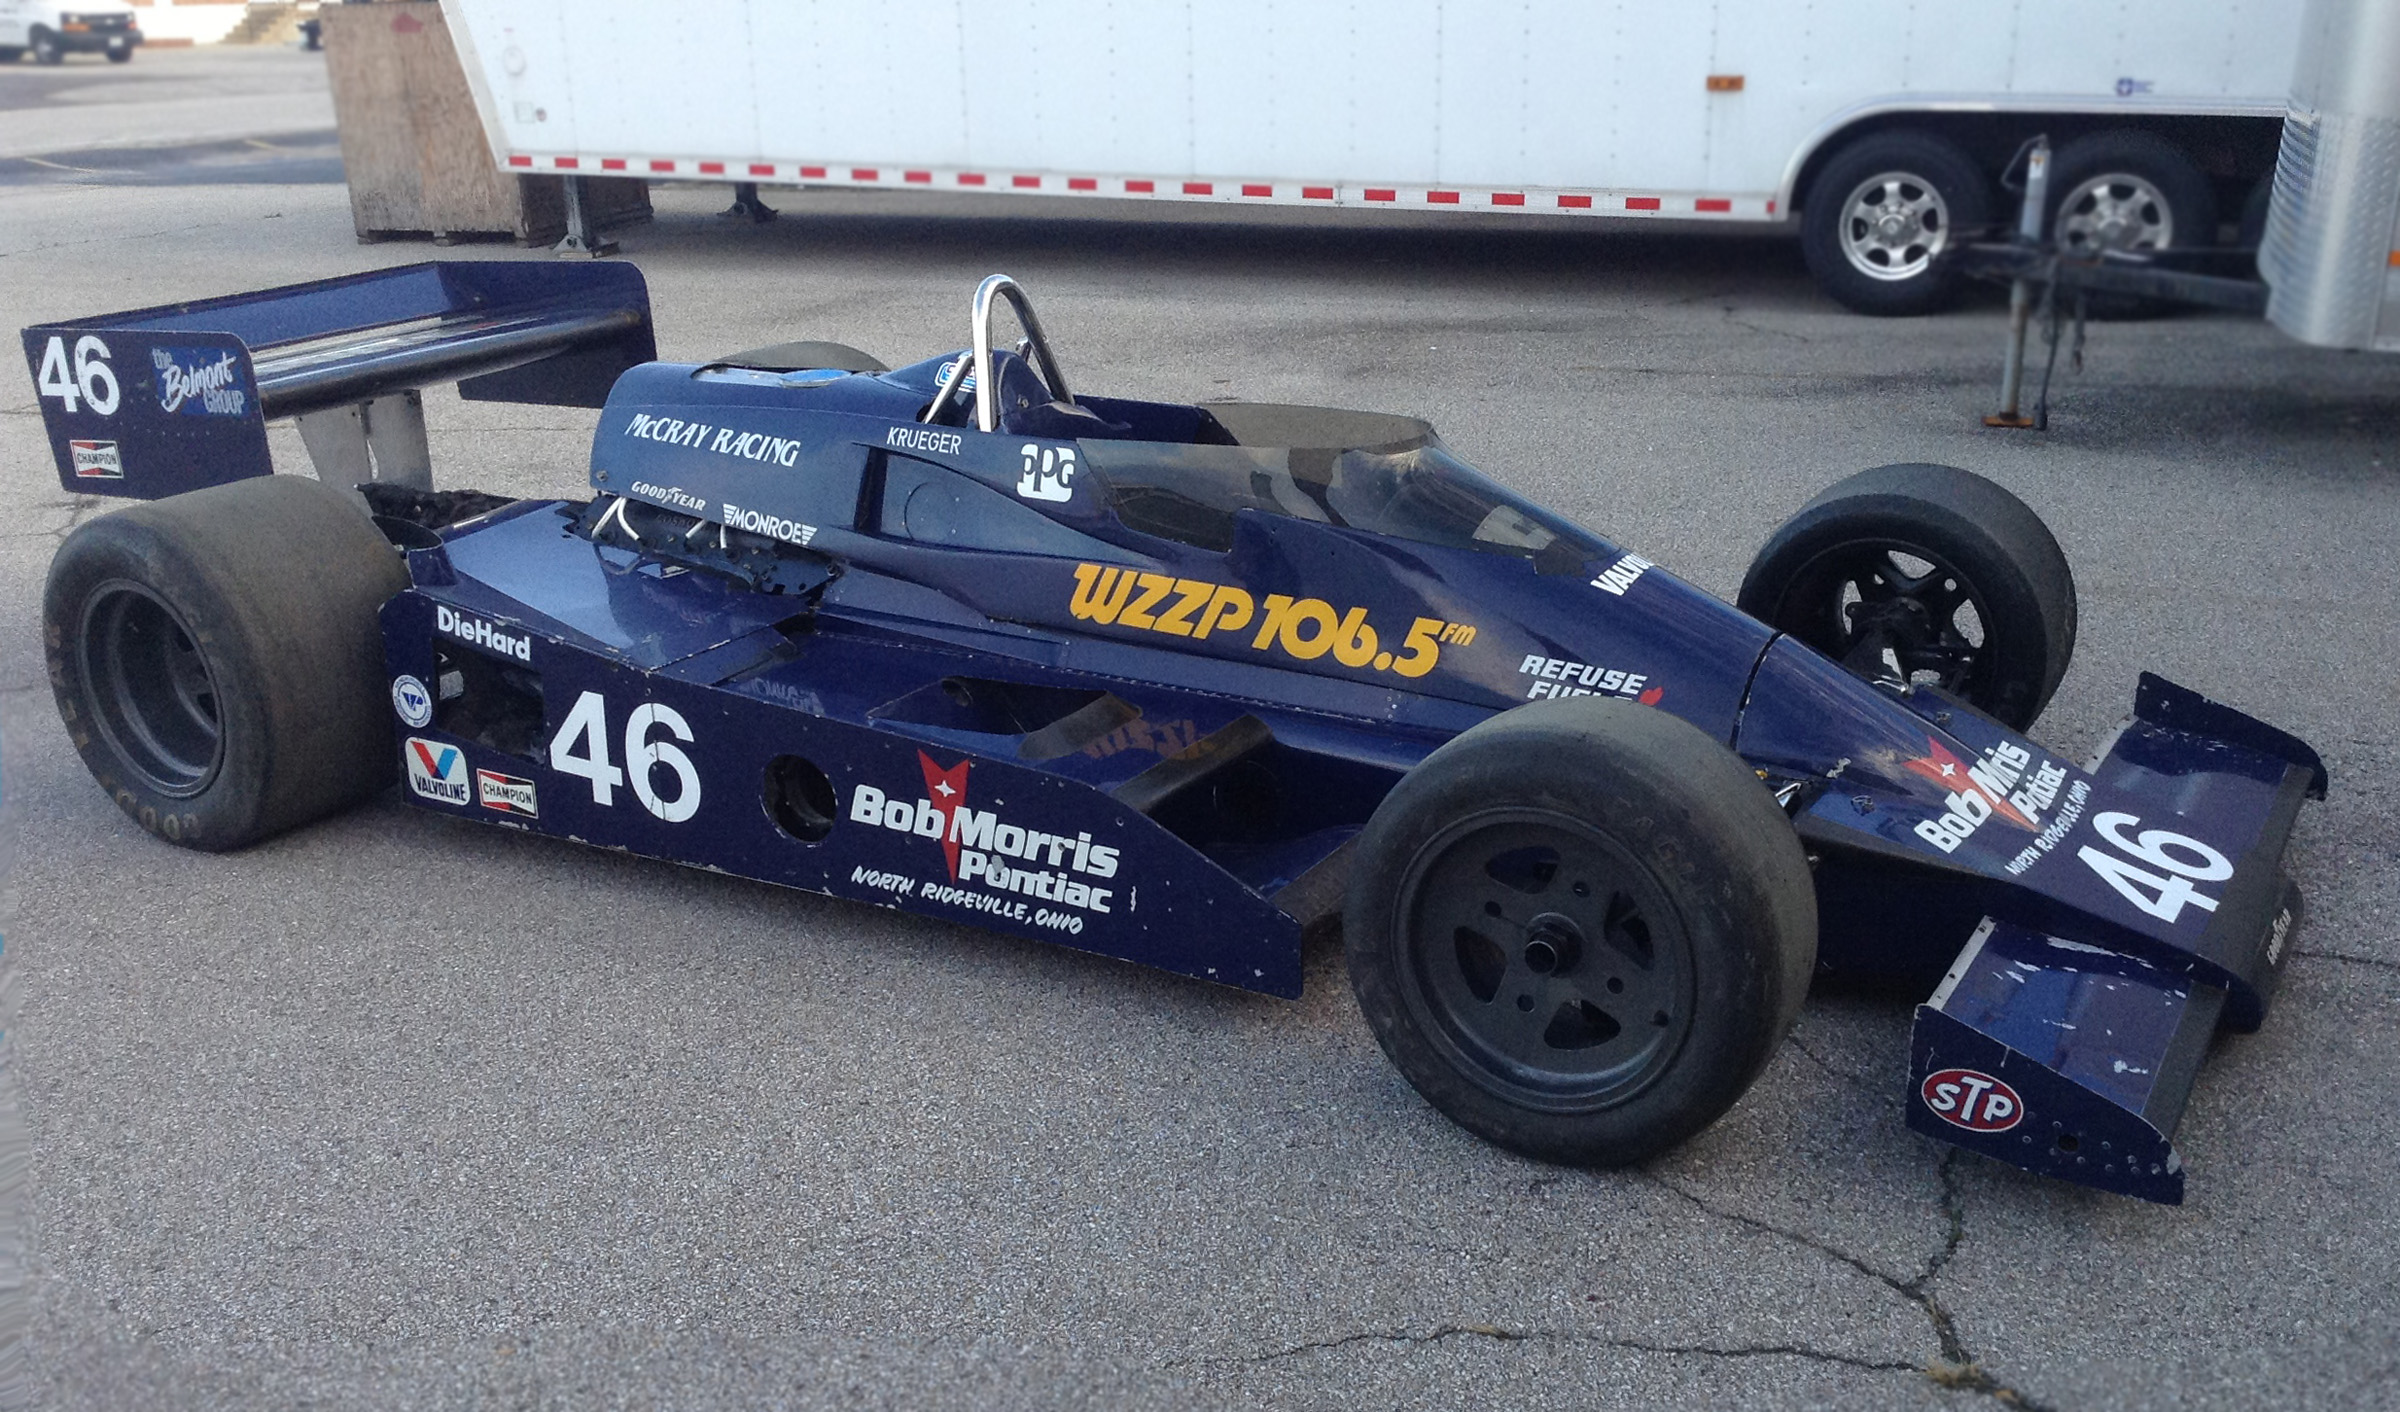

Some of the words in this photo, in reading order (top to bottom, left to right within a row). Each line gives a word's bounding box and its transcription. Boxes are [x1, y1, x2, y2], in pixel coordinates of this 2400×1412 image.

[38, 335, 120, 415] 46
[152, 347, 174, 370] the
[161, 351, 237, 413] Belmont
[203, 389, 245, 414] GROUP
[77, 452, 117, 465] CHAMPION
[624, 413, 713, 448] McCRAY
[710, 428, 801, 467] RACING
[886, 426, 962, 455] KRUEGER
[631, 481, 706, 511] GOODYEAR
[729, 507, 804, 544] MONROE
[1590, 553, 1655, 596] VALVO
[437, 605, 531, 661] DieHard
[1068, 563, 1254, 640] WZZP
[1251, 593, 1444, 678] 106.5
[1440, 622, 1478, 647] FM
[1519, 654, 1648, 695] REFUSE
[550, 690, 701, 823] 46
[414, 773, 466, 802] VALVOLINE
[483, 782, 533, 805] CHAMPION
[850, 784, 946, 839] Bob
[949, 805, 1120, 878] Morris
[1914, 788, 1993, 854] Bob
[958, 849, 1113, 913] Pontiac
[2076, 811, 2235, 924] 46
[851, 866, 916, 896] NORTH
[1034, 908, 1084, 935] OHIO
[1930, 1075, 2014, 1122] STP
